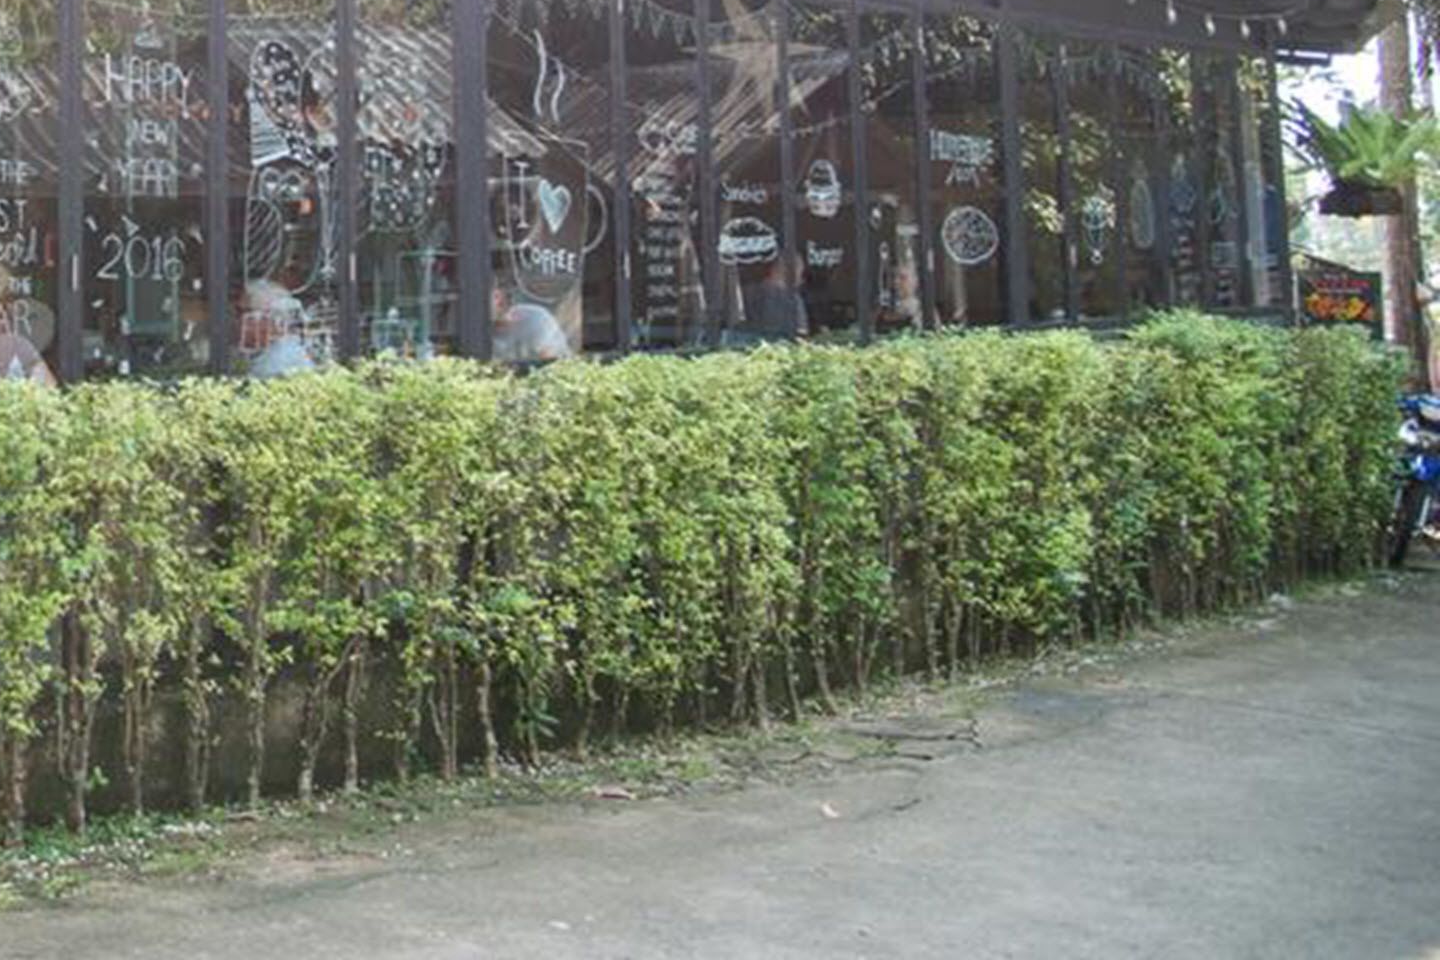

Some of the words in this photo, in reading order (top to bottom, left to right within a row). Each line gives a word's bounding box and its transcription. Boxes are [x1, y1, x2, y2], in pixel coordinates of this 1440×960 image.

[105, 52, 194, 118] HAPPY
[0, 158, 35, 183] THE
[116, 157, 178, 198] YEAR
[96, 232, 186, 280] 2016
[520, 239, 576, 276] COFFEE
